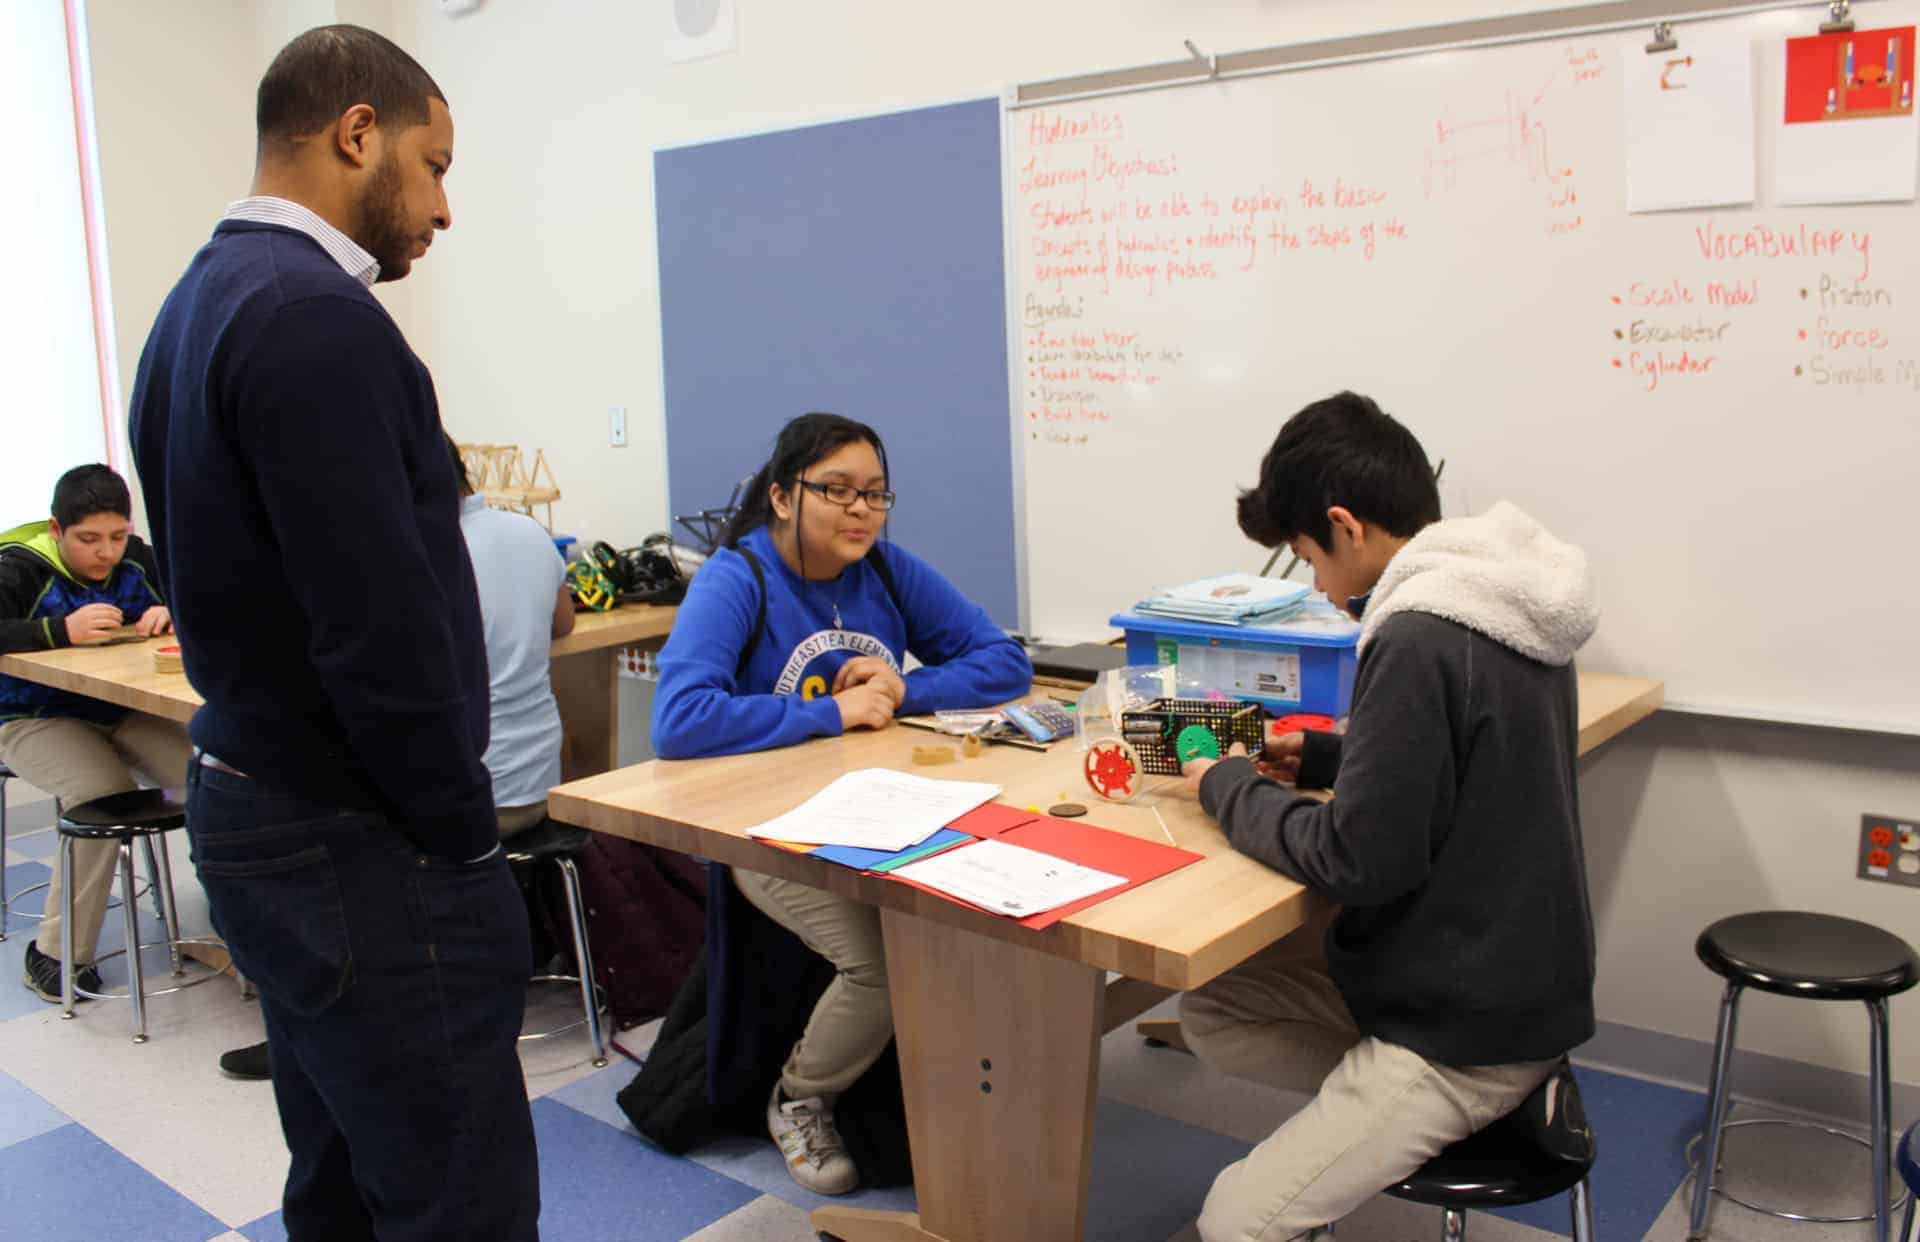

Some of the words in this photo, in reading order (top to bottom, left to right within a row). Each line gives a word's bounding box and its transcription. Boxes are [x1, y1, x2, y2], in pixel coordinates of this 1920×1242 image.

[1200, 191, 1221, 216] to
[1299, 176, 1327, 208] the
[1267, 219, 1301, 256] the
[1629, 279, 1694, 306] Scale
[1819, 272, 1892, 308] Piston
[1629, 318, 1731, 343] Excavator
[1817, 316, 1889, 349] Force
[1629, 352, 1716, 391] Cylinder
